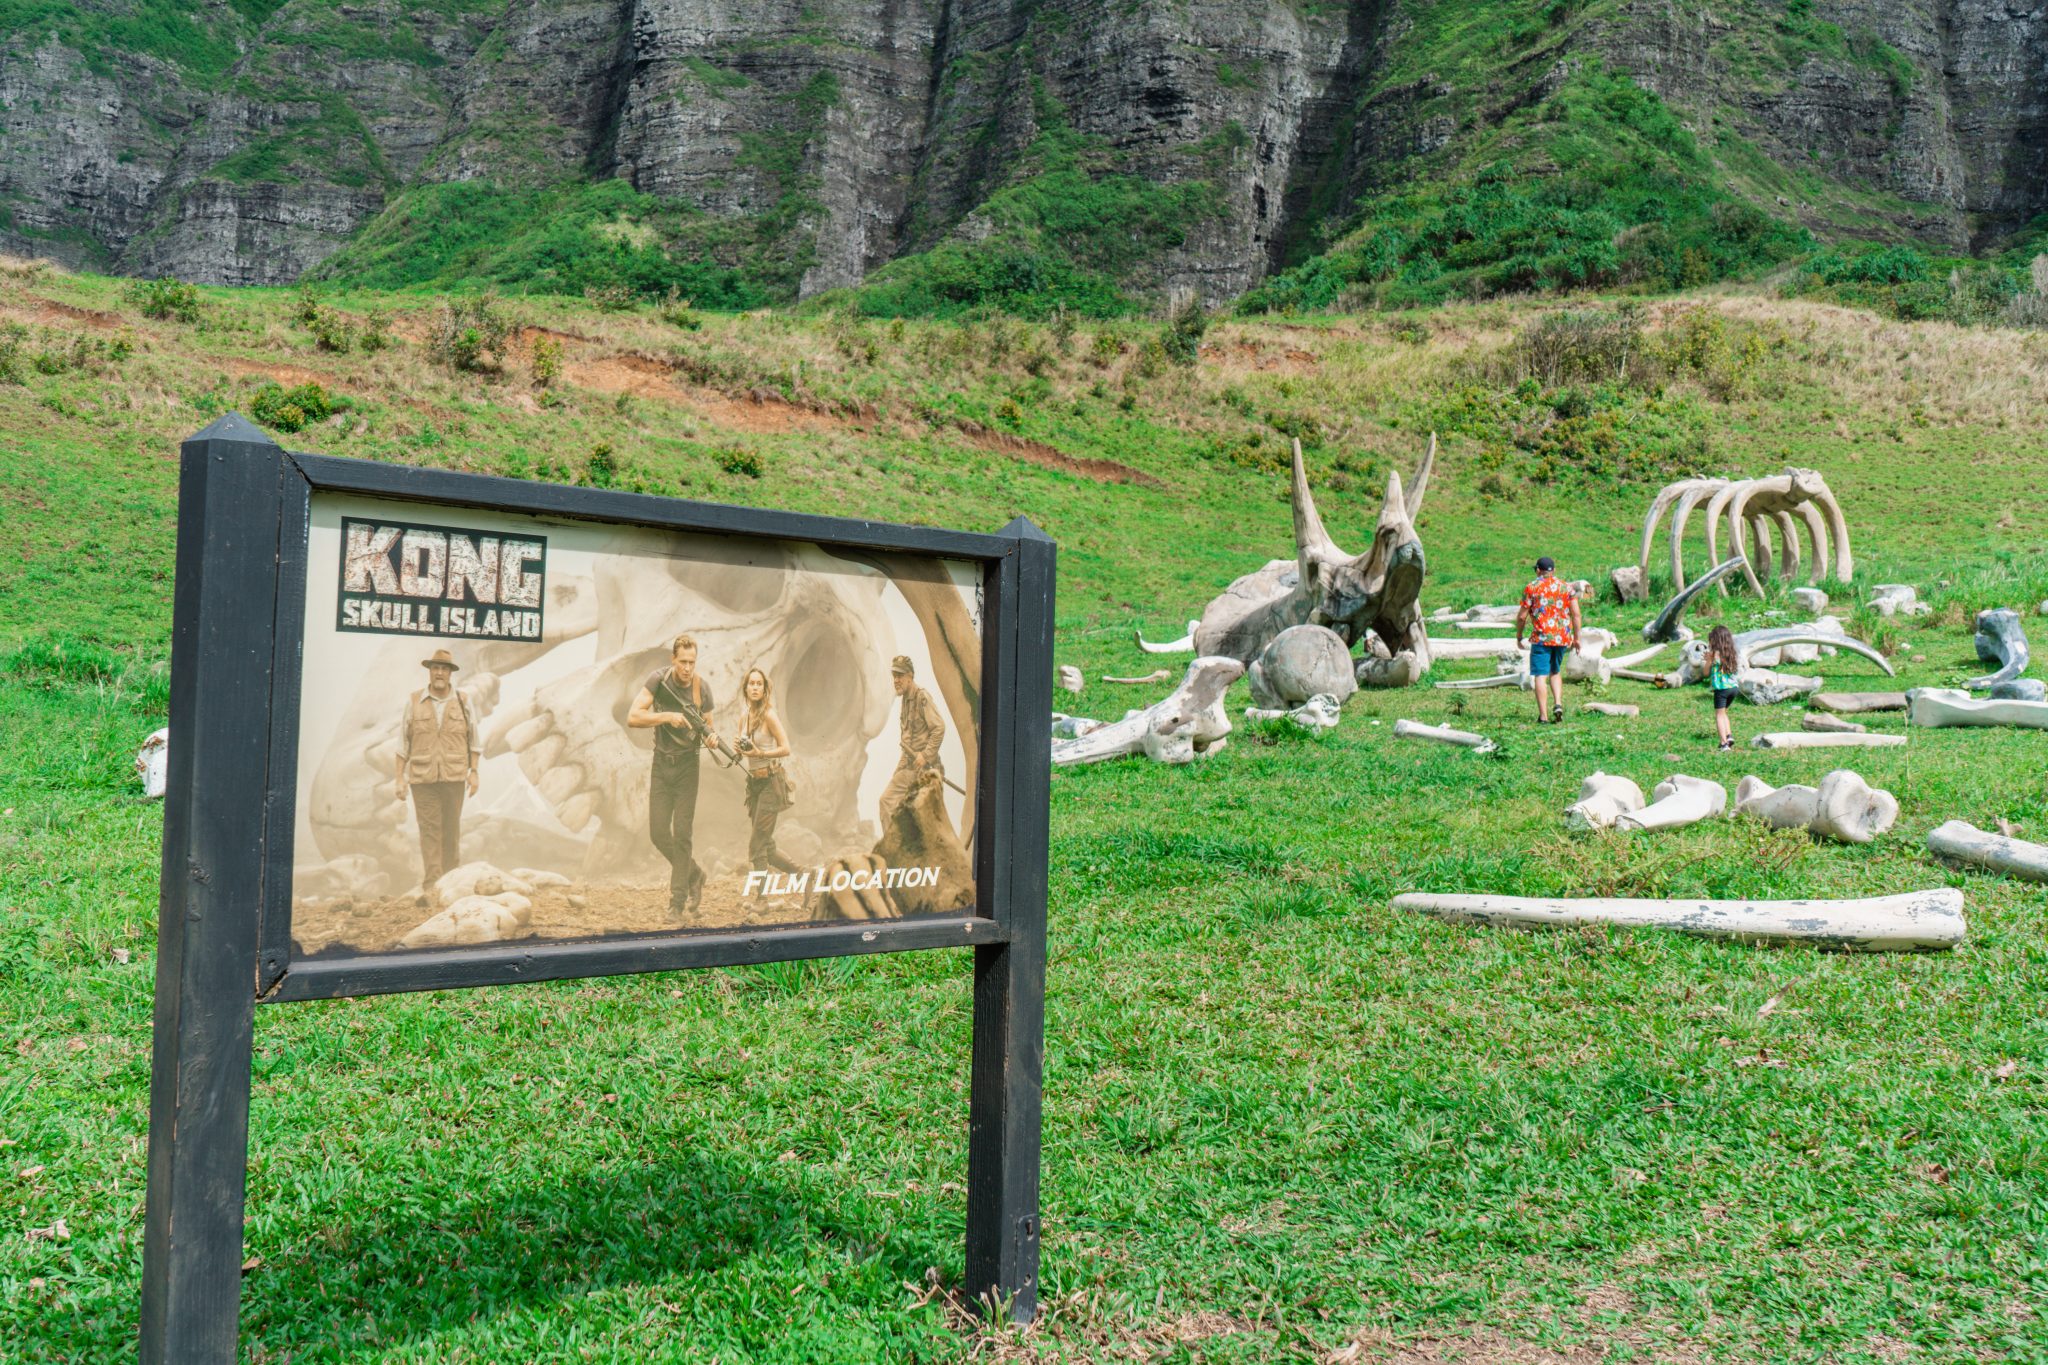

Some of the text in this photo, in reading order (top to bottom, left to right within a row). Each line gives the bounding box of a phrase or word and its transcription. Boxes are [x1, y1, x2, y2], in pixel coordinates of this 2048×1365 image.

[343, 521, 543, 608] KONG
[342, 598, 541, 638] SKULL ISLAND
[741, 865, 941, 897] FILM LOCATION
